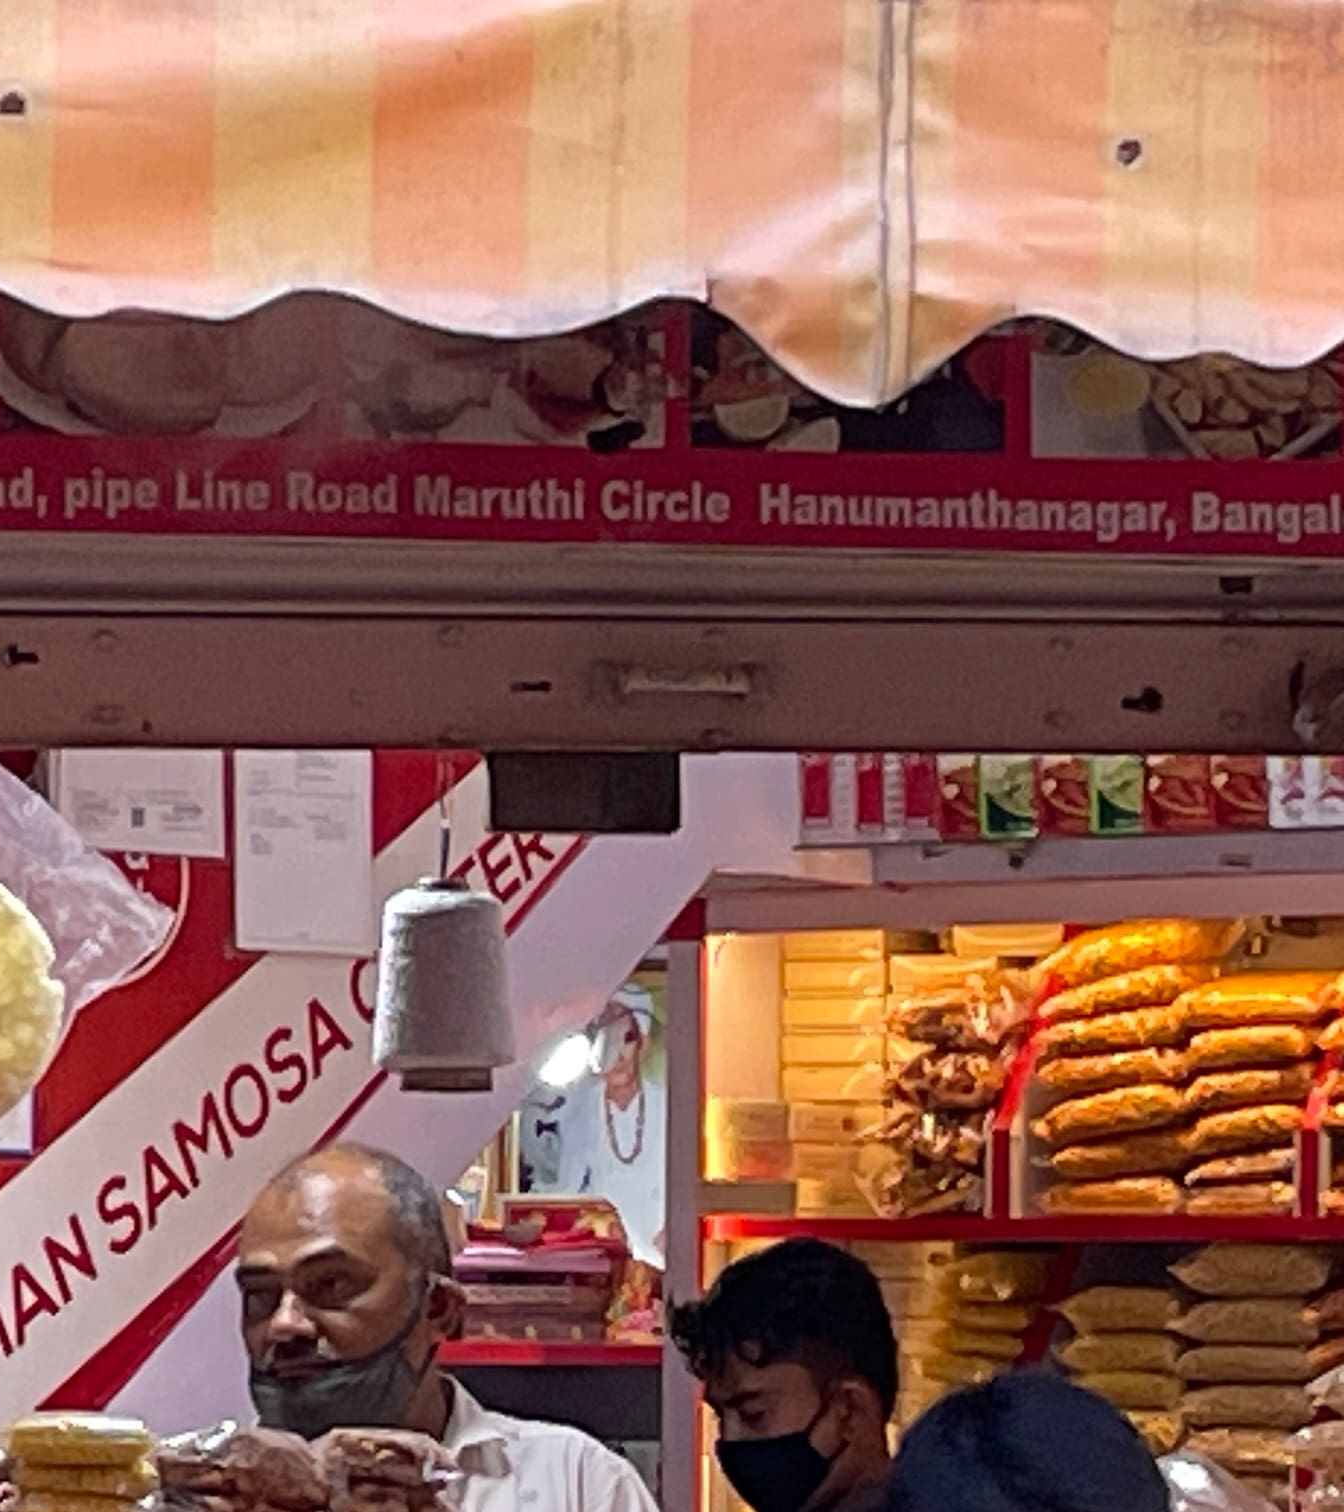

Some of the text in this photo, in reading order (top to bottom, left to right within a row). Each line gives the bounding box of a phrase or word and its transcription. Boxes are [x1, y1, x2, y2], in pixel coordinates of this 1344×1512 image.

[64, 471, 158, 519] pipe
[177, 470, 269, 510] Line
[288, 471, 397, 513] Road
[414, 474, 585, 519] Maruthi
[601, 479, 731, 523] Circle
[759, 483, 1176, 542] Hanumanthanagar,
[96, 997, 354, 1257] SAMOSA
